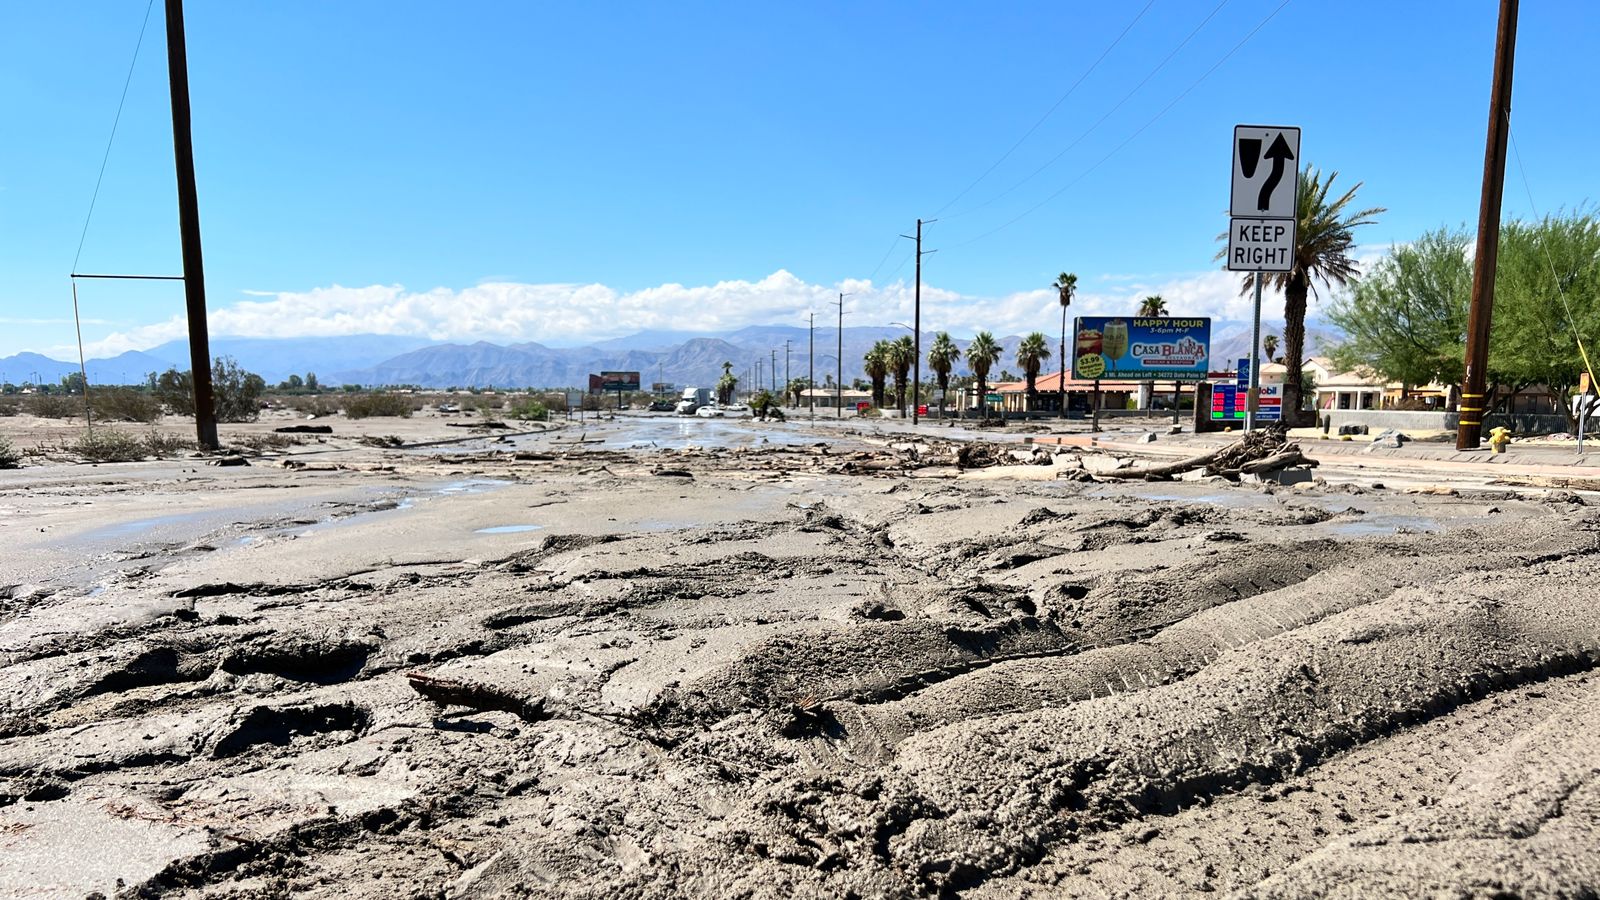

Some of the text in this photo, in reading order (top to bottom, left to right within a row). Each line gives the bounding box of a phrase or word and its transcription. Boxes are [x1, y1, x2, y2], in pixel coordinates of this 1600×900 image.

[1239, 225, 1285, 242] KEEP
[1234, 247, 1288, 264] RIGHT
[1133, 319, 1204, 328] HAPPY HOUR
[1132, 344, 1160, 356] CASA
[1080, 355, 1100, 365] $3.99
